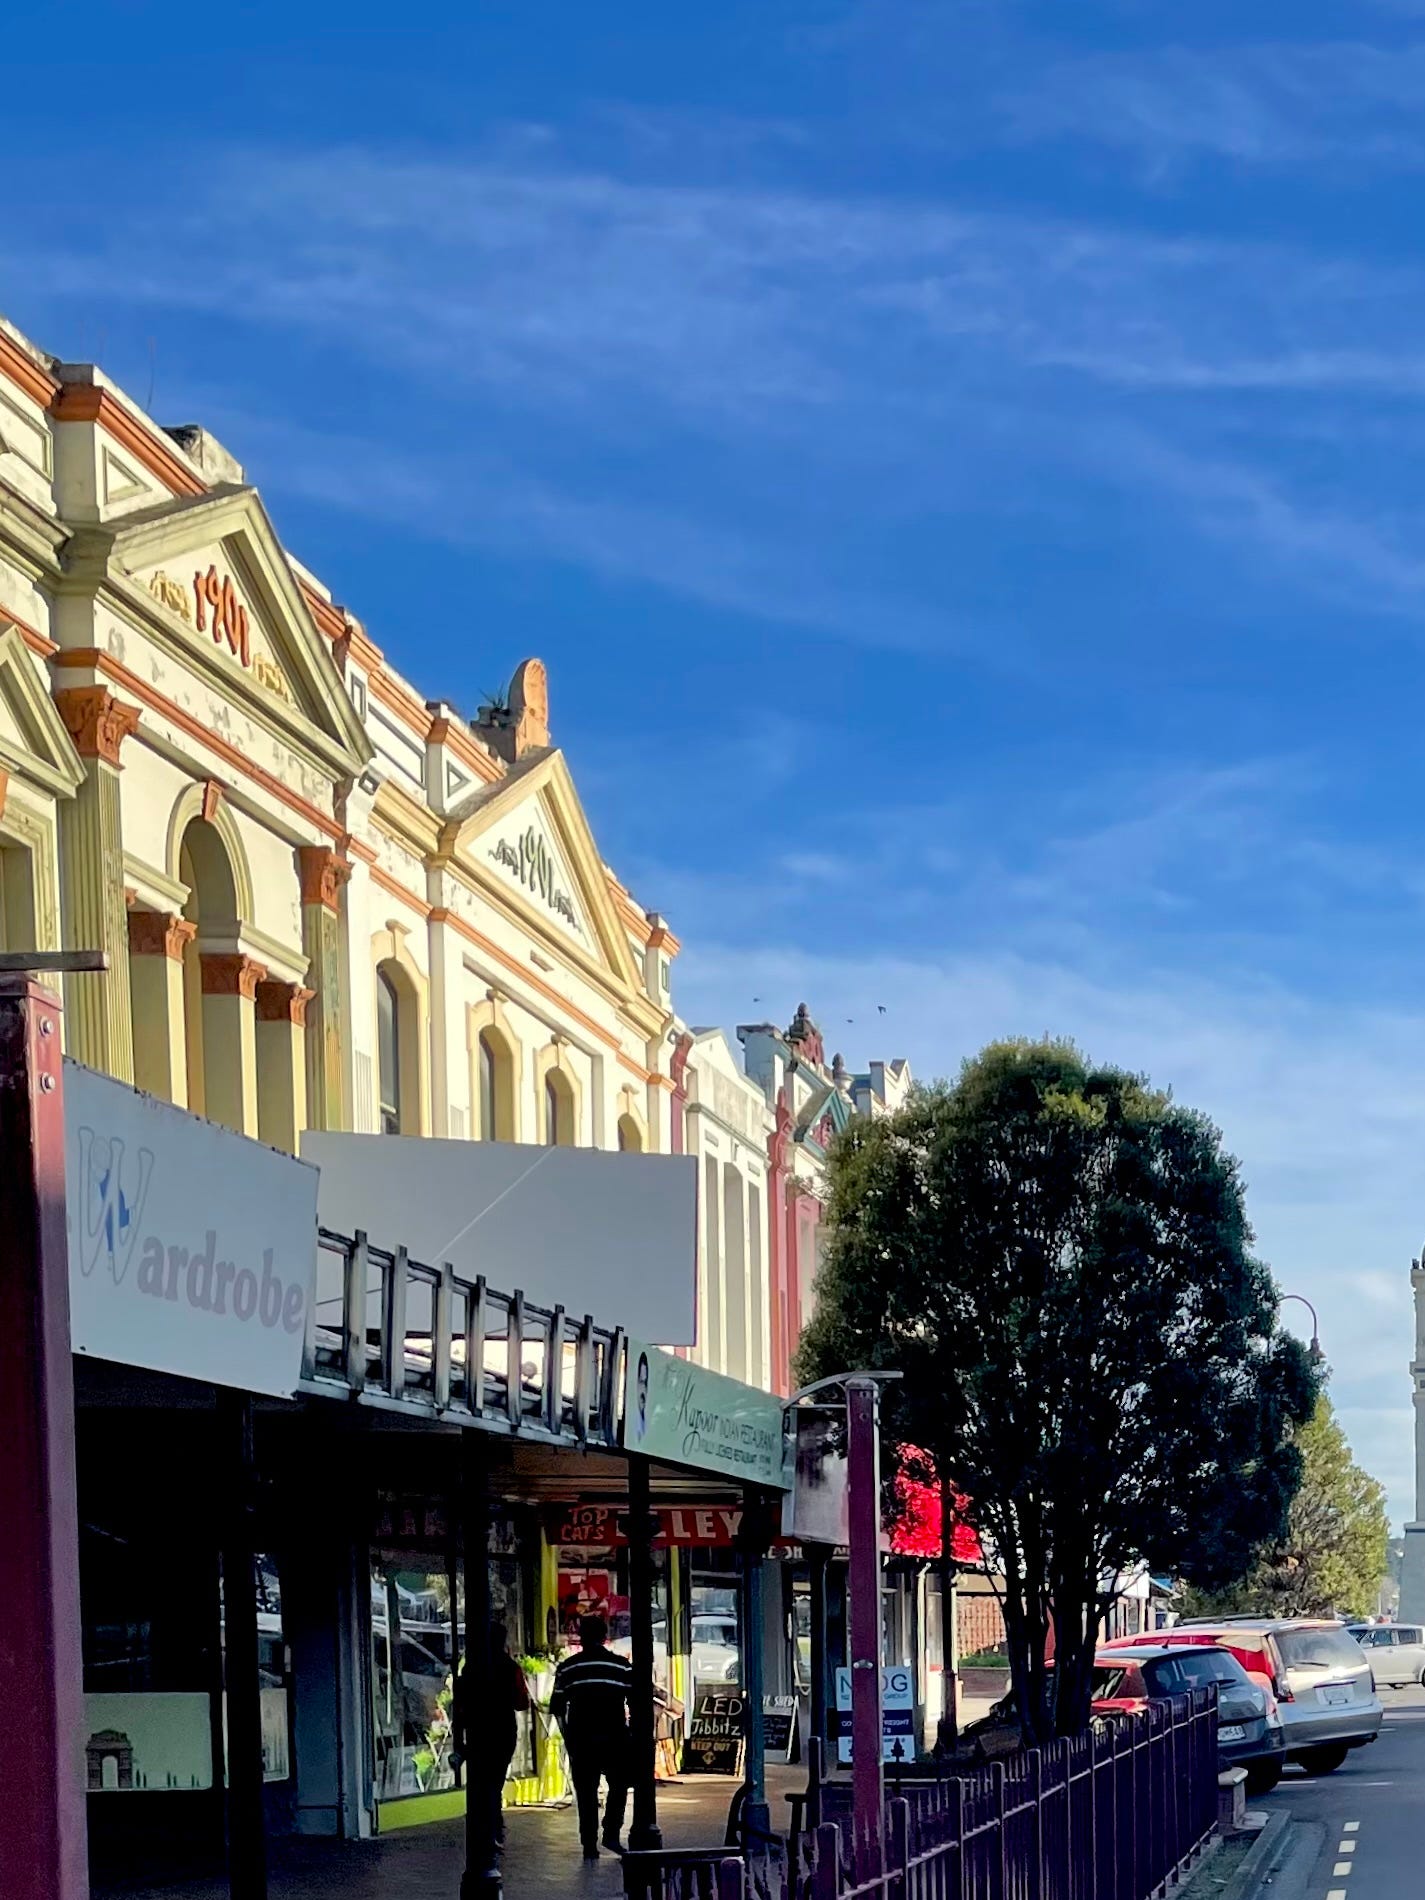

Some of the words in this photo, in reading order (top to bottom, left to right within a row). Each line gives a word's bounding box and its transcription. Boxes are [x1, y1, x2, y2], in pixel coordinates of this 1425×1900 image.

[193, 564, 250, 668] 1901
[518, 825, 553, 909] 1901
[78, 1126, 304, 1334] Wardrobe
[567, 1508, 609, 1525] TOP
[700, 1696, 743, 1716] LED
